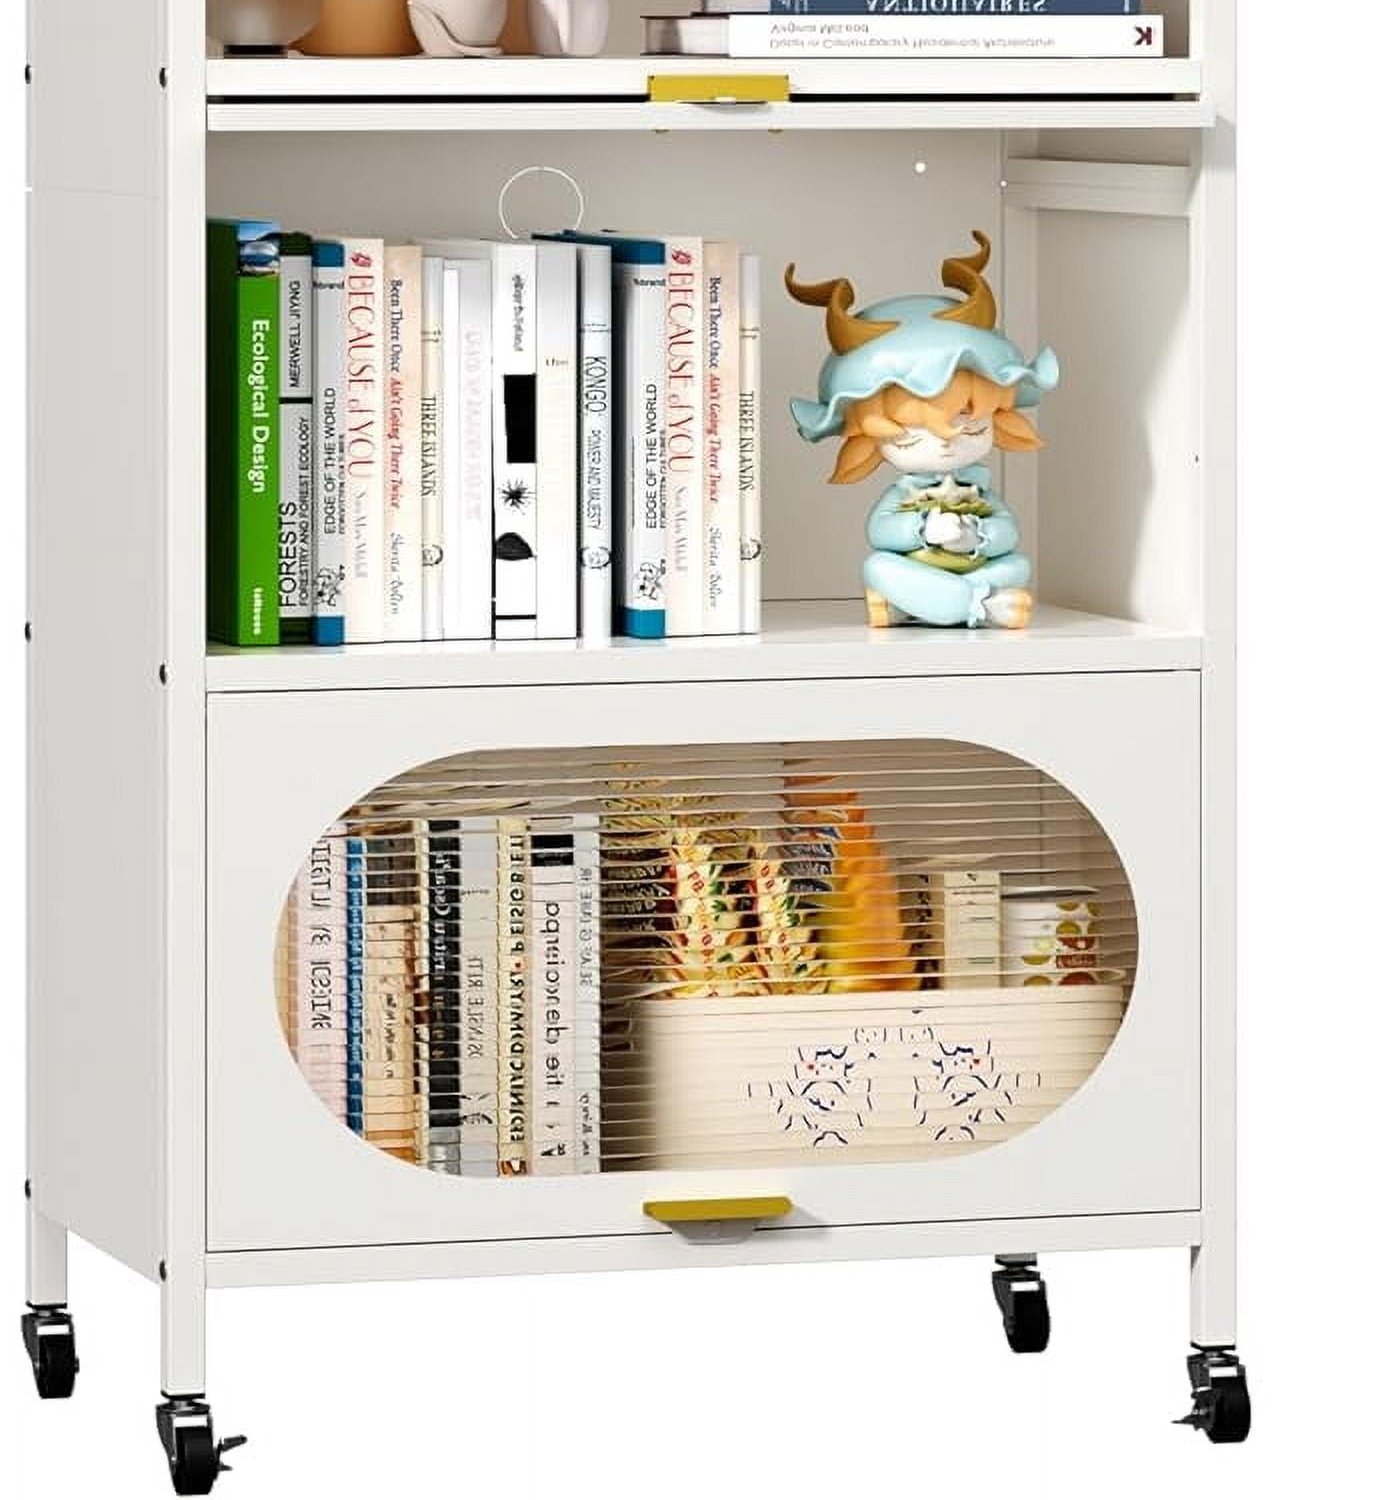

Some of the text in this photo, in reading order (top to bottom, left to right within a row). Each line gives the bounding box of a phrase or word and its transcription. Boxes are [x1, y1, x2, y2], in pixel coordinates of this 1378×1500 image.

[389, 280, 402, 307] Been
[708, 277, 721, 303] Been
[347, 274, 375, 391] BECAUSE
[389, 310, 402, 341] There
[667, 271, 695, 389] BECAUSE
[708, 306, 721, 337] There
[289, 322, 301, 388] MERWELL
[389, 344, 402, 372] Once
[708, 340, 721, 368] Once
[247, 318, 270, 493] Ecological Design
[324, 387, 336, 535] EDGE OF THE WORLD
[348, 420, 375, 478] YOU
[389, 444, 403, 475] There
[421, 396, 436, 497] THREE ISLANDS
[645, 383, 657, 529] EDGE OF THE WORLD
[668, 415, 695, 473] YOU
[708, 439, 721, 470] There
[739, 391, 755, 492] THREE ISLANDS
[299, 417, 310, 607] FORESTRY AND FOREST ECOLOGY
[389, 478, 403, 508] Twice
[708, 474, 722, 504] Twice
[279, 501, 297, 607] FORESTS
